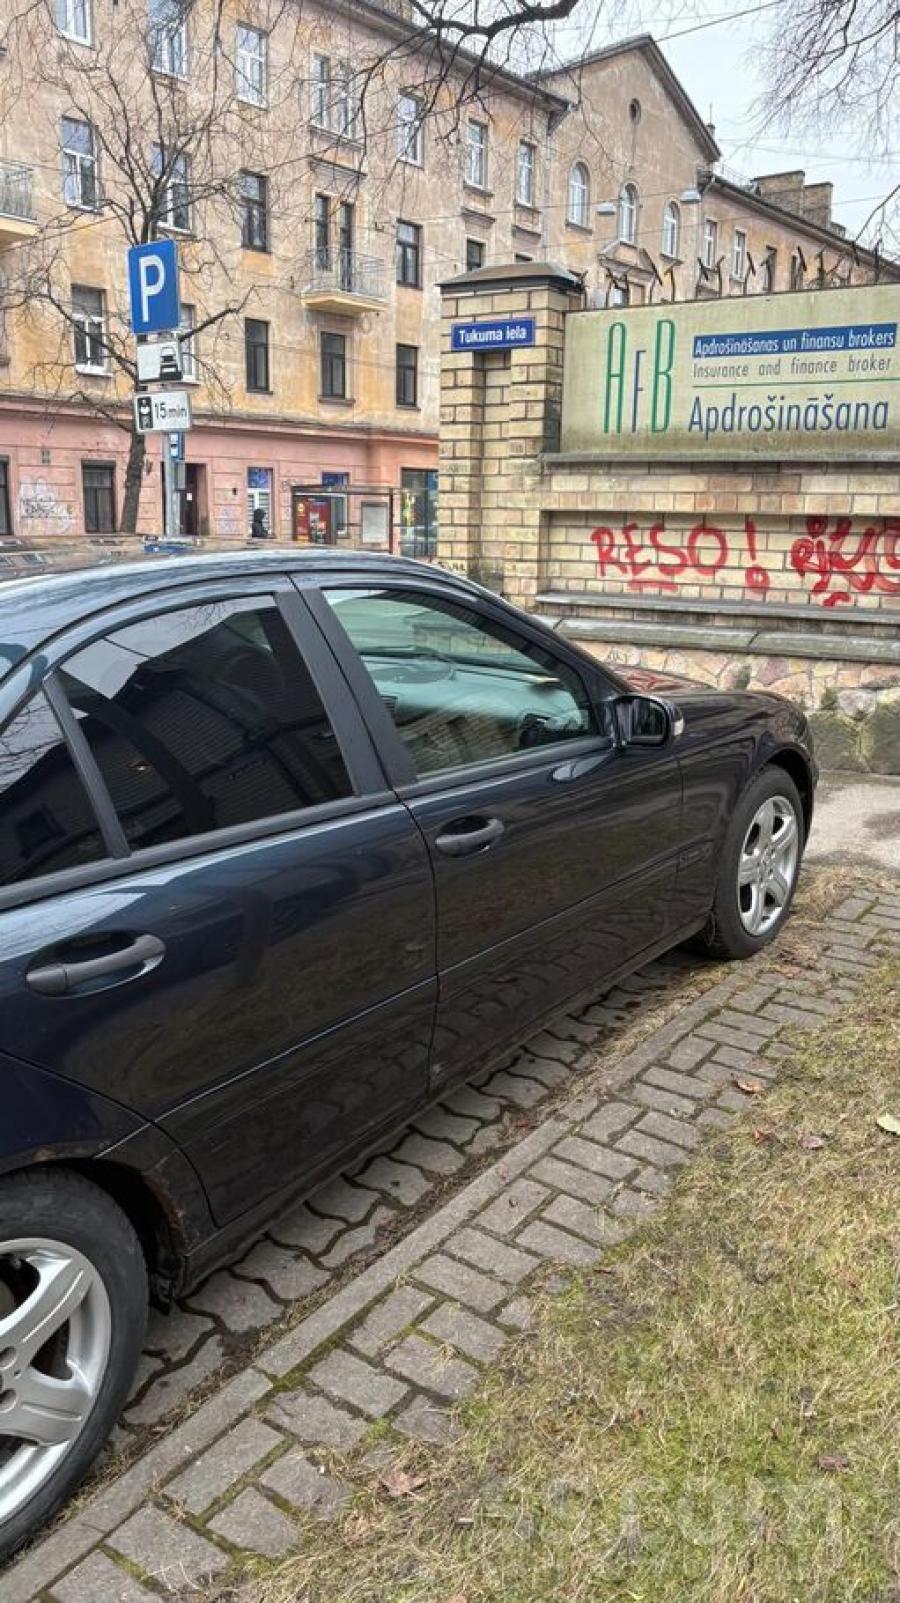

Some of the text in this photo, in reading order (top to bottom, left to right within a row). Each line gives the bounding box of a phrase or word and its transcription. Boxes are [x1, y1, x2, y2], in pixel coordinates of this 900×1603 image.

[139, 255, 165, 323] P
[458, 328, 503, 345] Tukuma
[783, 338, 797, 350] un
[800, 332, 844, 350] finansu
[849, 328, 895, 347] brokers
[693, 354, 892, 379] Insurance and finance broker
[154, 402, 187, 419] 15 min
[688, 393, 889, 440] Apdrošināšana
